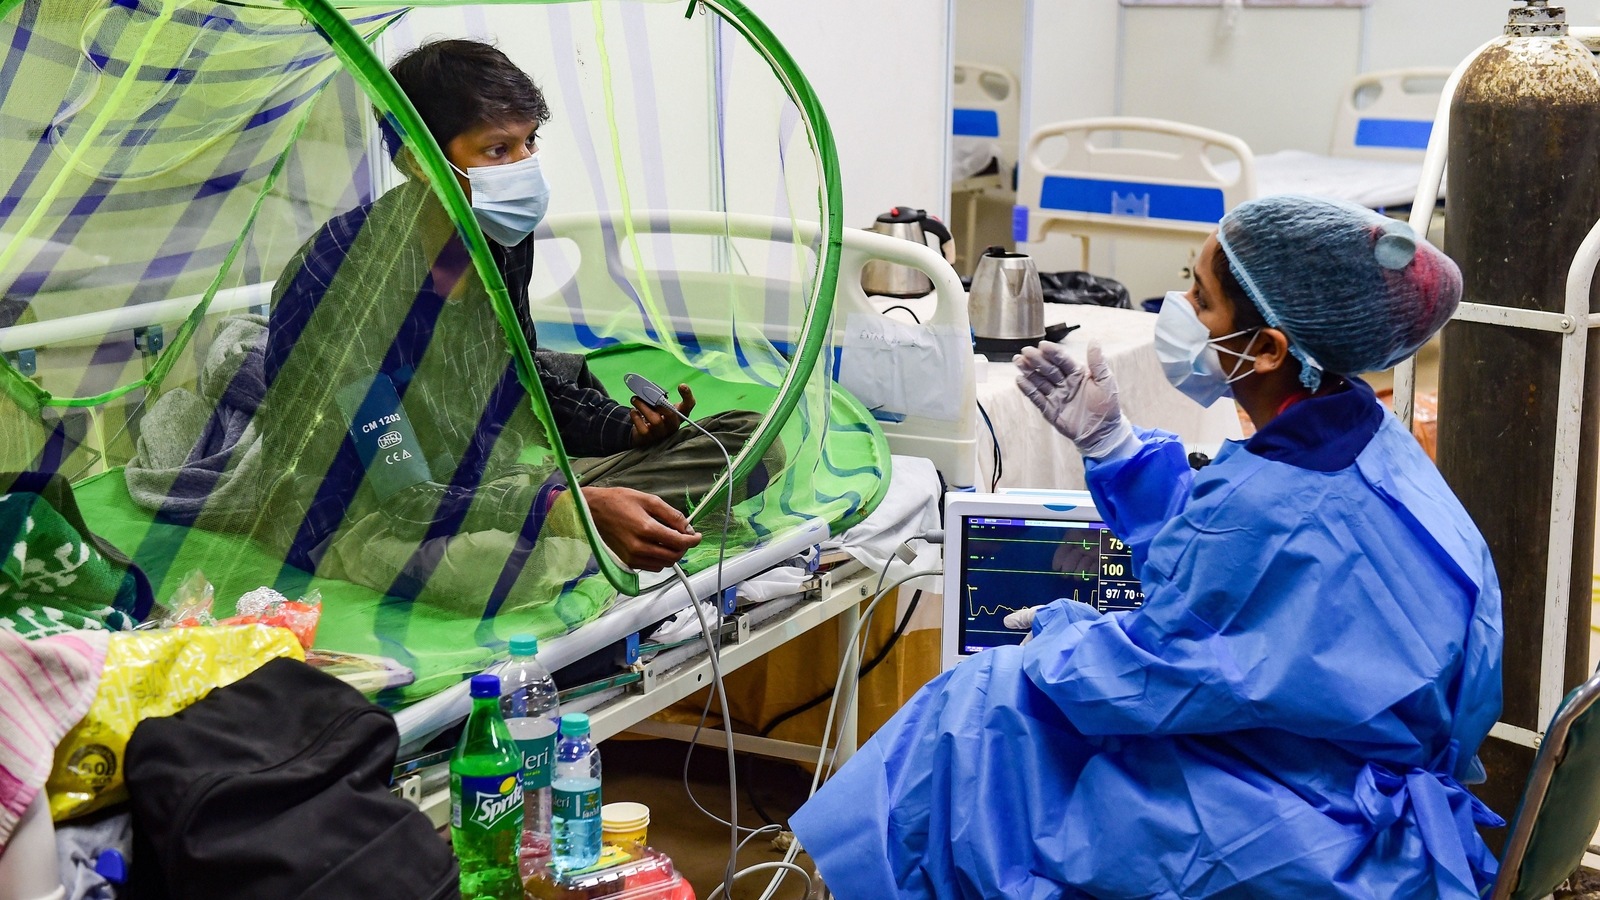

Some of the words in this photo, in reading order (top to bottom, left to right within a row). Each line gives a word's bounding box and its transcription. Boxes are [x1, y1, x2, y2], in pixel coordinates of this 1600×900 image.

[362, 420, 378, 433] CM
[378, 413, 401, 426] 1203
[380, 432, 402, 448] LATEX
[1109, 537, 1124, 551] 75
[1102, 563, 1124, 576] 100
[1124, 589, 1135, 600] 70
[521, 746, 549, 770] leri
